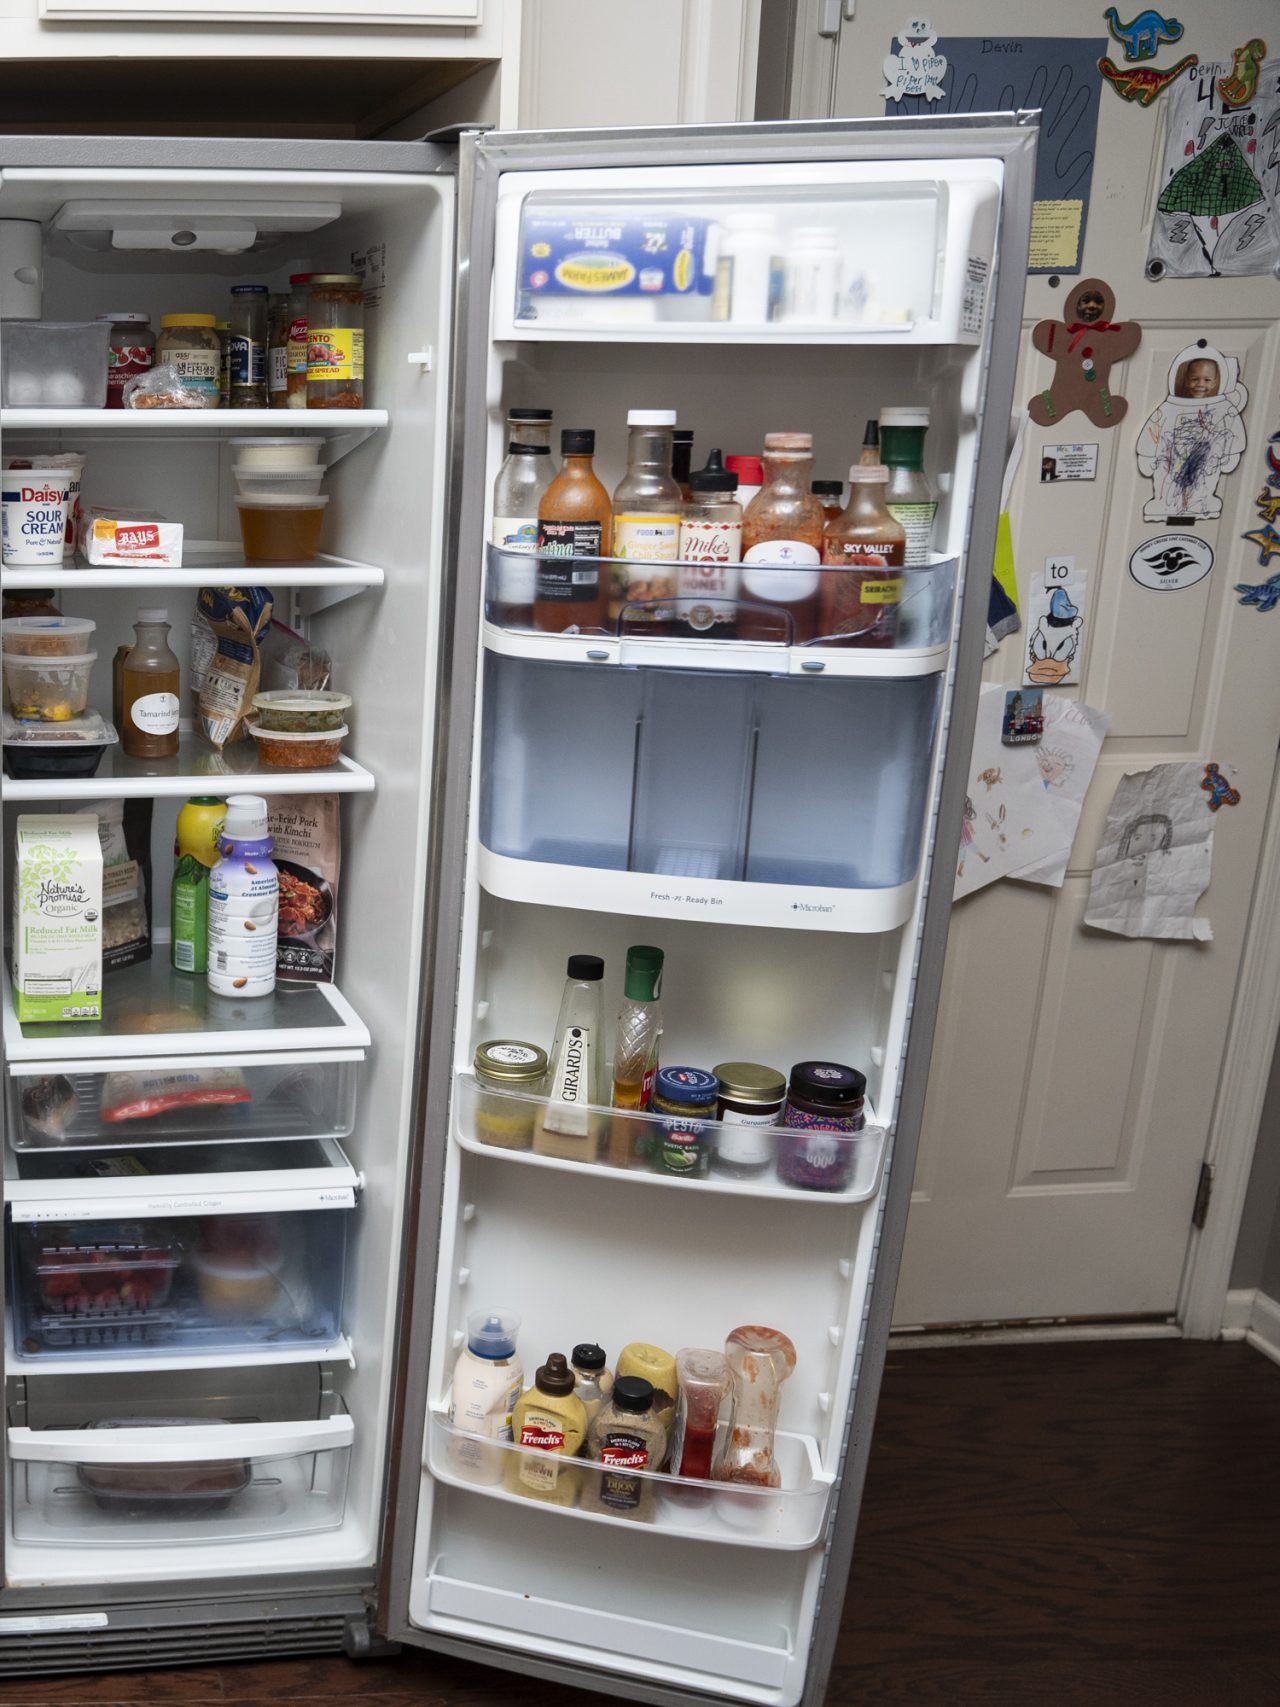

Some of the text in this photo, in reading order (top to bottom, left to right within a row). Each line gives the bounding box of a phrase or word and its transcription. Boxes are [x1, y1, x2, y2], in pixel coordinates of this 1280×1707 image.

[981, 39, 1023, 53] Devin
[21, 487, 64, 505] Daisy
[26, 510, 61, 522] SOUR
[21, 522, 64, 535] CREAM
[119, 530, 155, 545] BAYS
[685, 534, 730, 555] Mike's
[843, 543, 895, 554] SKY VALLEY
[1050, 562, 1069, 580] to
[139, 709, 170, 717] Tamarind
[299, 815, 319, 828] Pork
[283, 826, 312, 838] Kimchi
[40, 880, 85, 895] Nature's
[38, 892, 90, 908] Promise
[650, 891, 723, 906] Fresh Ready Bin
[45, 904, 78, 914] Organic
[30, 925, 98, 934] Reduced Fat Milk
[561, 1037, 583, 1102] GIRARD'S
[522, 1431, 562, 1445] French's
[603, 1454, 647, 1466] French's
